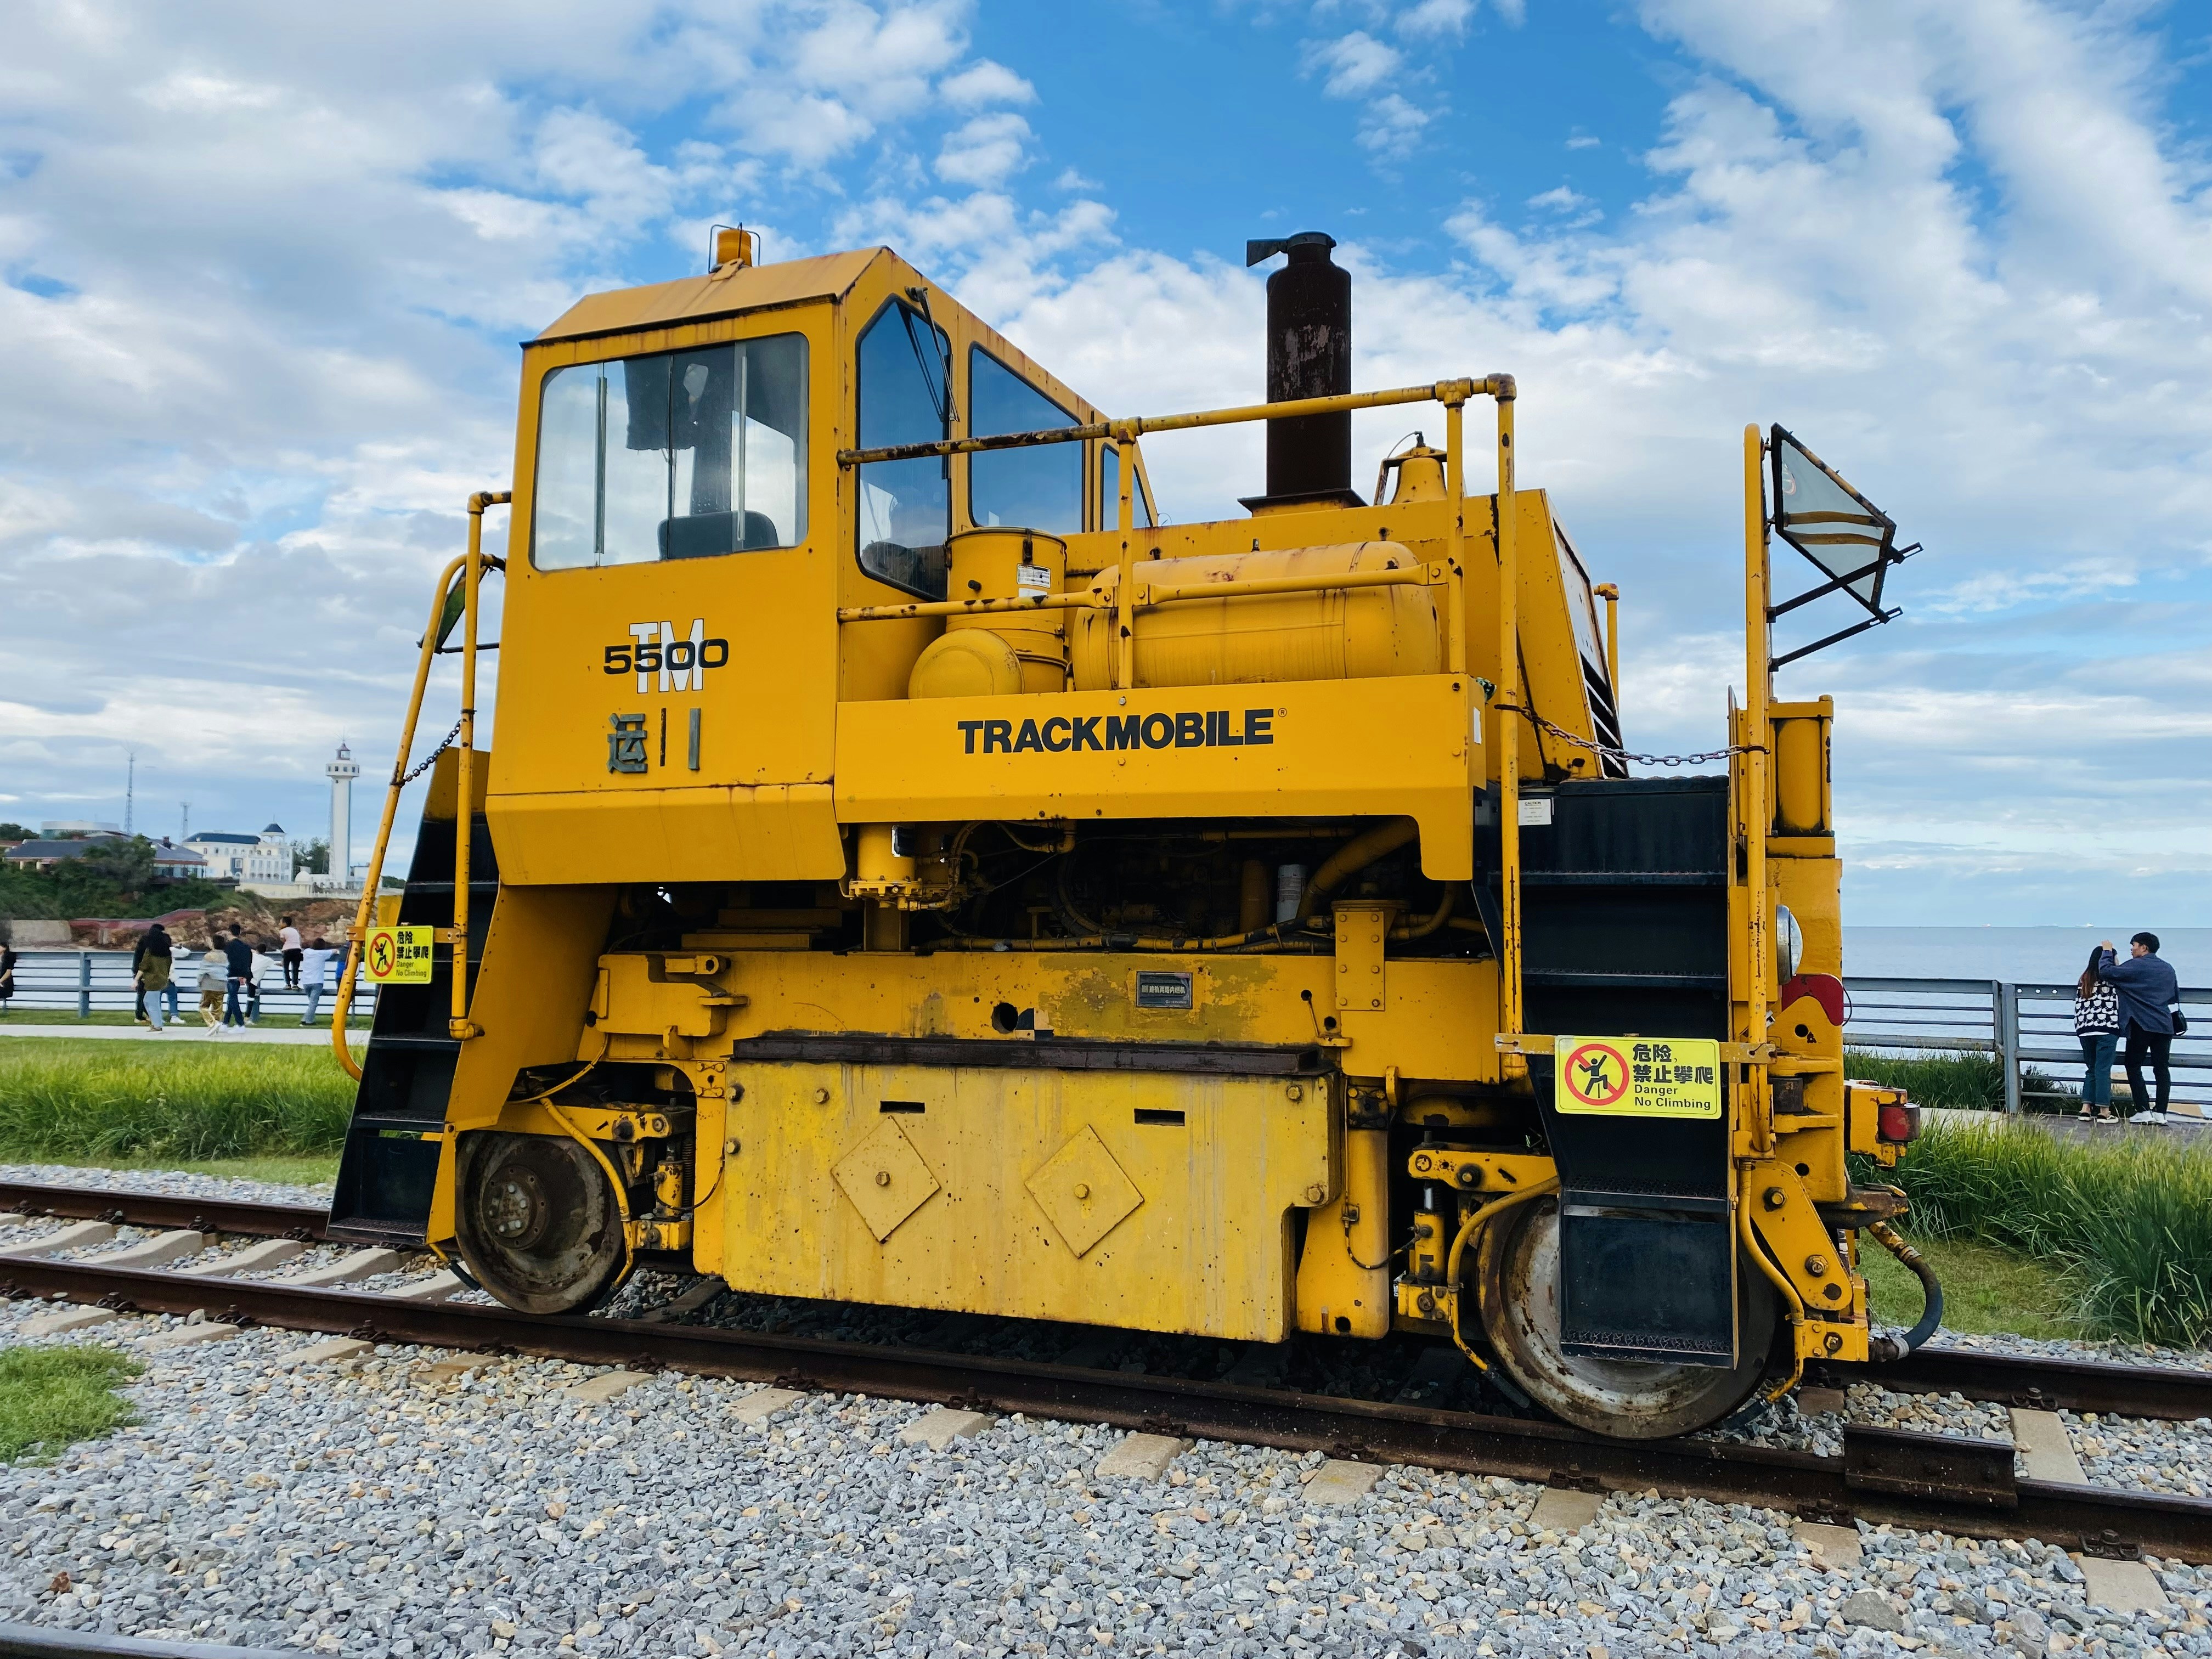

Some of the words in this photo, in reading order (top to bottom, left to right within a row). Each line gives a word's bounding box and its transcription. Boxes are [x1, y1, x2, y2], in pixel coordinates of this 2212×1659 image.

[603, 638, 729, 674] 5500
[629, 618, 704, 693] TM
[397, 946, 429, 959] 禁止攀爬
[404, 969, 427, 978] Climbing
[1633, 1064, 1714, 1085] 禁止攀爬
[1634, 1084, 1678, 1096] Danger
[1635, 1097, 1651, 1106] No
[1656, 1097, 1711, 1110] Climbing
